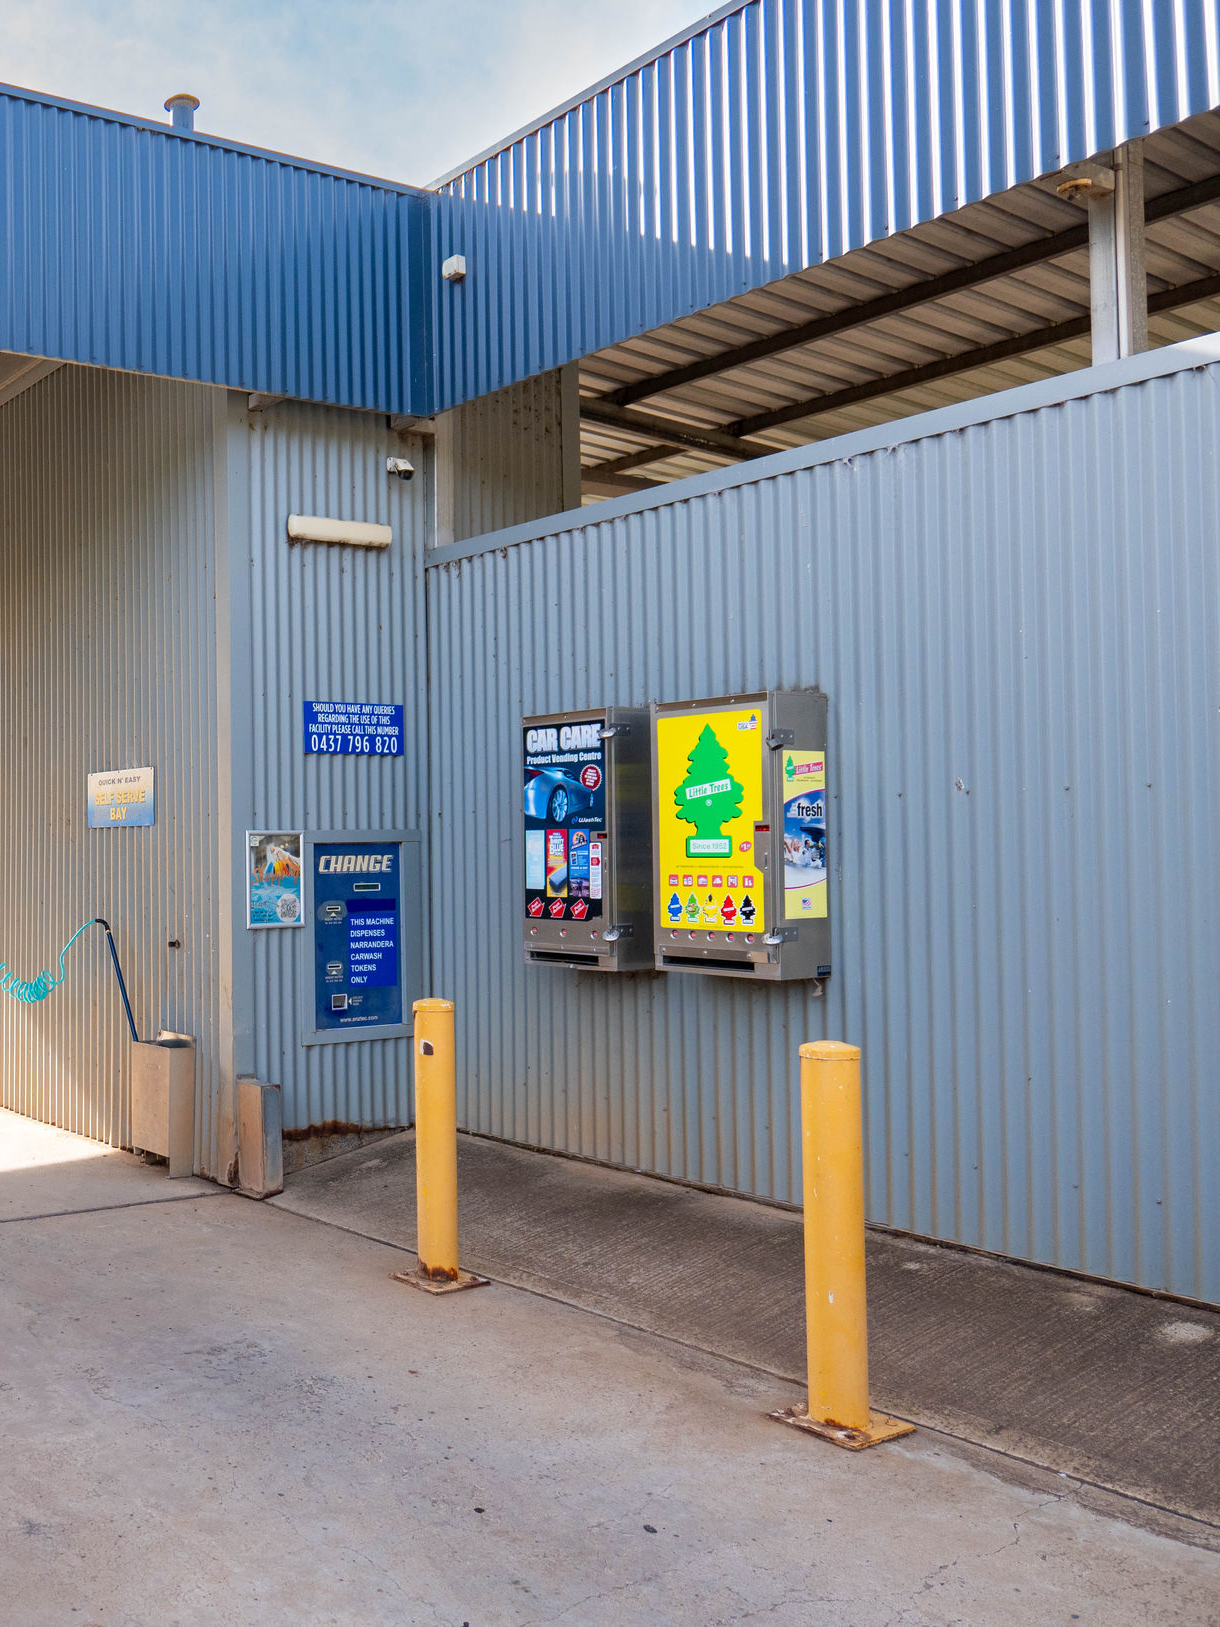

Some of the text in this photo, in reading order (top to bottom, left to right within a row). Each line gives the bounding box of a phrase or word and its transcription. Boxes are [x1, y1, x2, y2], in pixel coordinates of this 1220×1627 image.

[312, 702, 395, 715] SHOULD YOU HAVE ANY QUERIES
[317, 713, 390, 725] REGARDING THE USE OF THIS
[308, 723, 399, 736] FACILITY PLEASE CALL THIS NUMBER
[311, 734, 398, 753] 0437 796 820
[526, 723, 601, 753] CAR CARE
[526, 752, 602, 765] Product Vending Centre
[98, 778, 116, 786] QUICK
[125, 775, 141, 784] EASY
[689, 781, 729, 798] Little Trees
[95, 788, 146, 806] SELF SERVE
[110, 806, 127, 821] BAY
[797, 802, 823, 817] fresh
[691, 842, 728, 850] Since 1952
[318, 854, 394, 874] CHANGE
[350, 918, 364, 926] THIS
[366, 917, 395, 926] MACHINE
[350, 929, 386, 938] DISPENSES
[350, 940, 394, 949] NARRANDERA
[350, 952, 382, 961] CARWASH
[350, 964, 377, 972] TOKENS
[350, 976, 368, 984] ONLY
